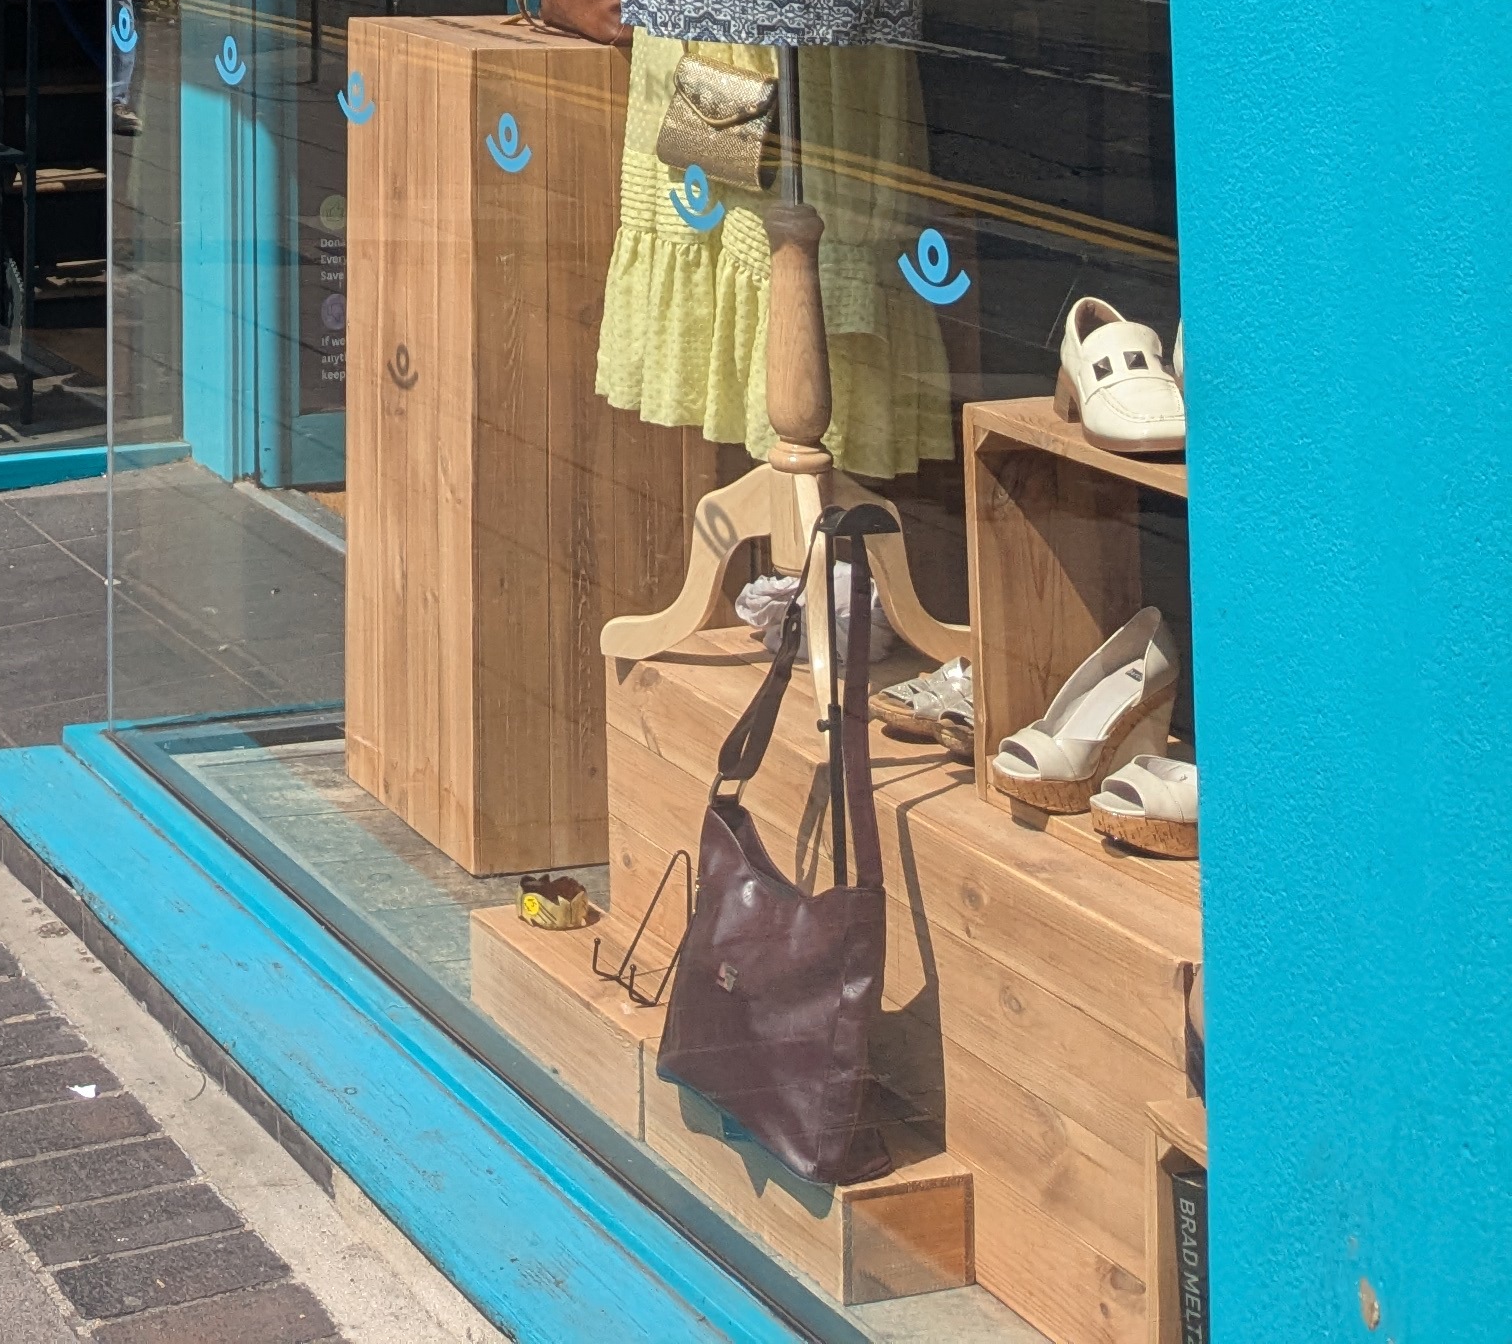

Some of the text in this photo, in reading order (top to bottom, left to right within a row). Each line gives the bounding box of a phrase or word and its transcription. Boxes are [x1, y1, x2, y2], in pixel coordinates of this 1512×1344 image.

[320, 238, 345, 248] Don
[321, 354, 346, 366] anyt
[1179, 1197, 1199, 1267] BRAD
